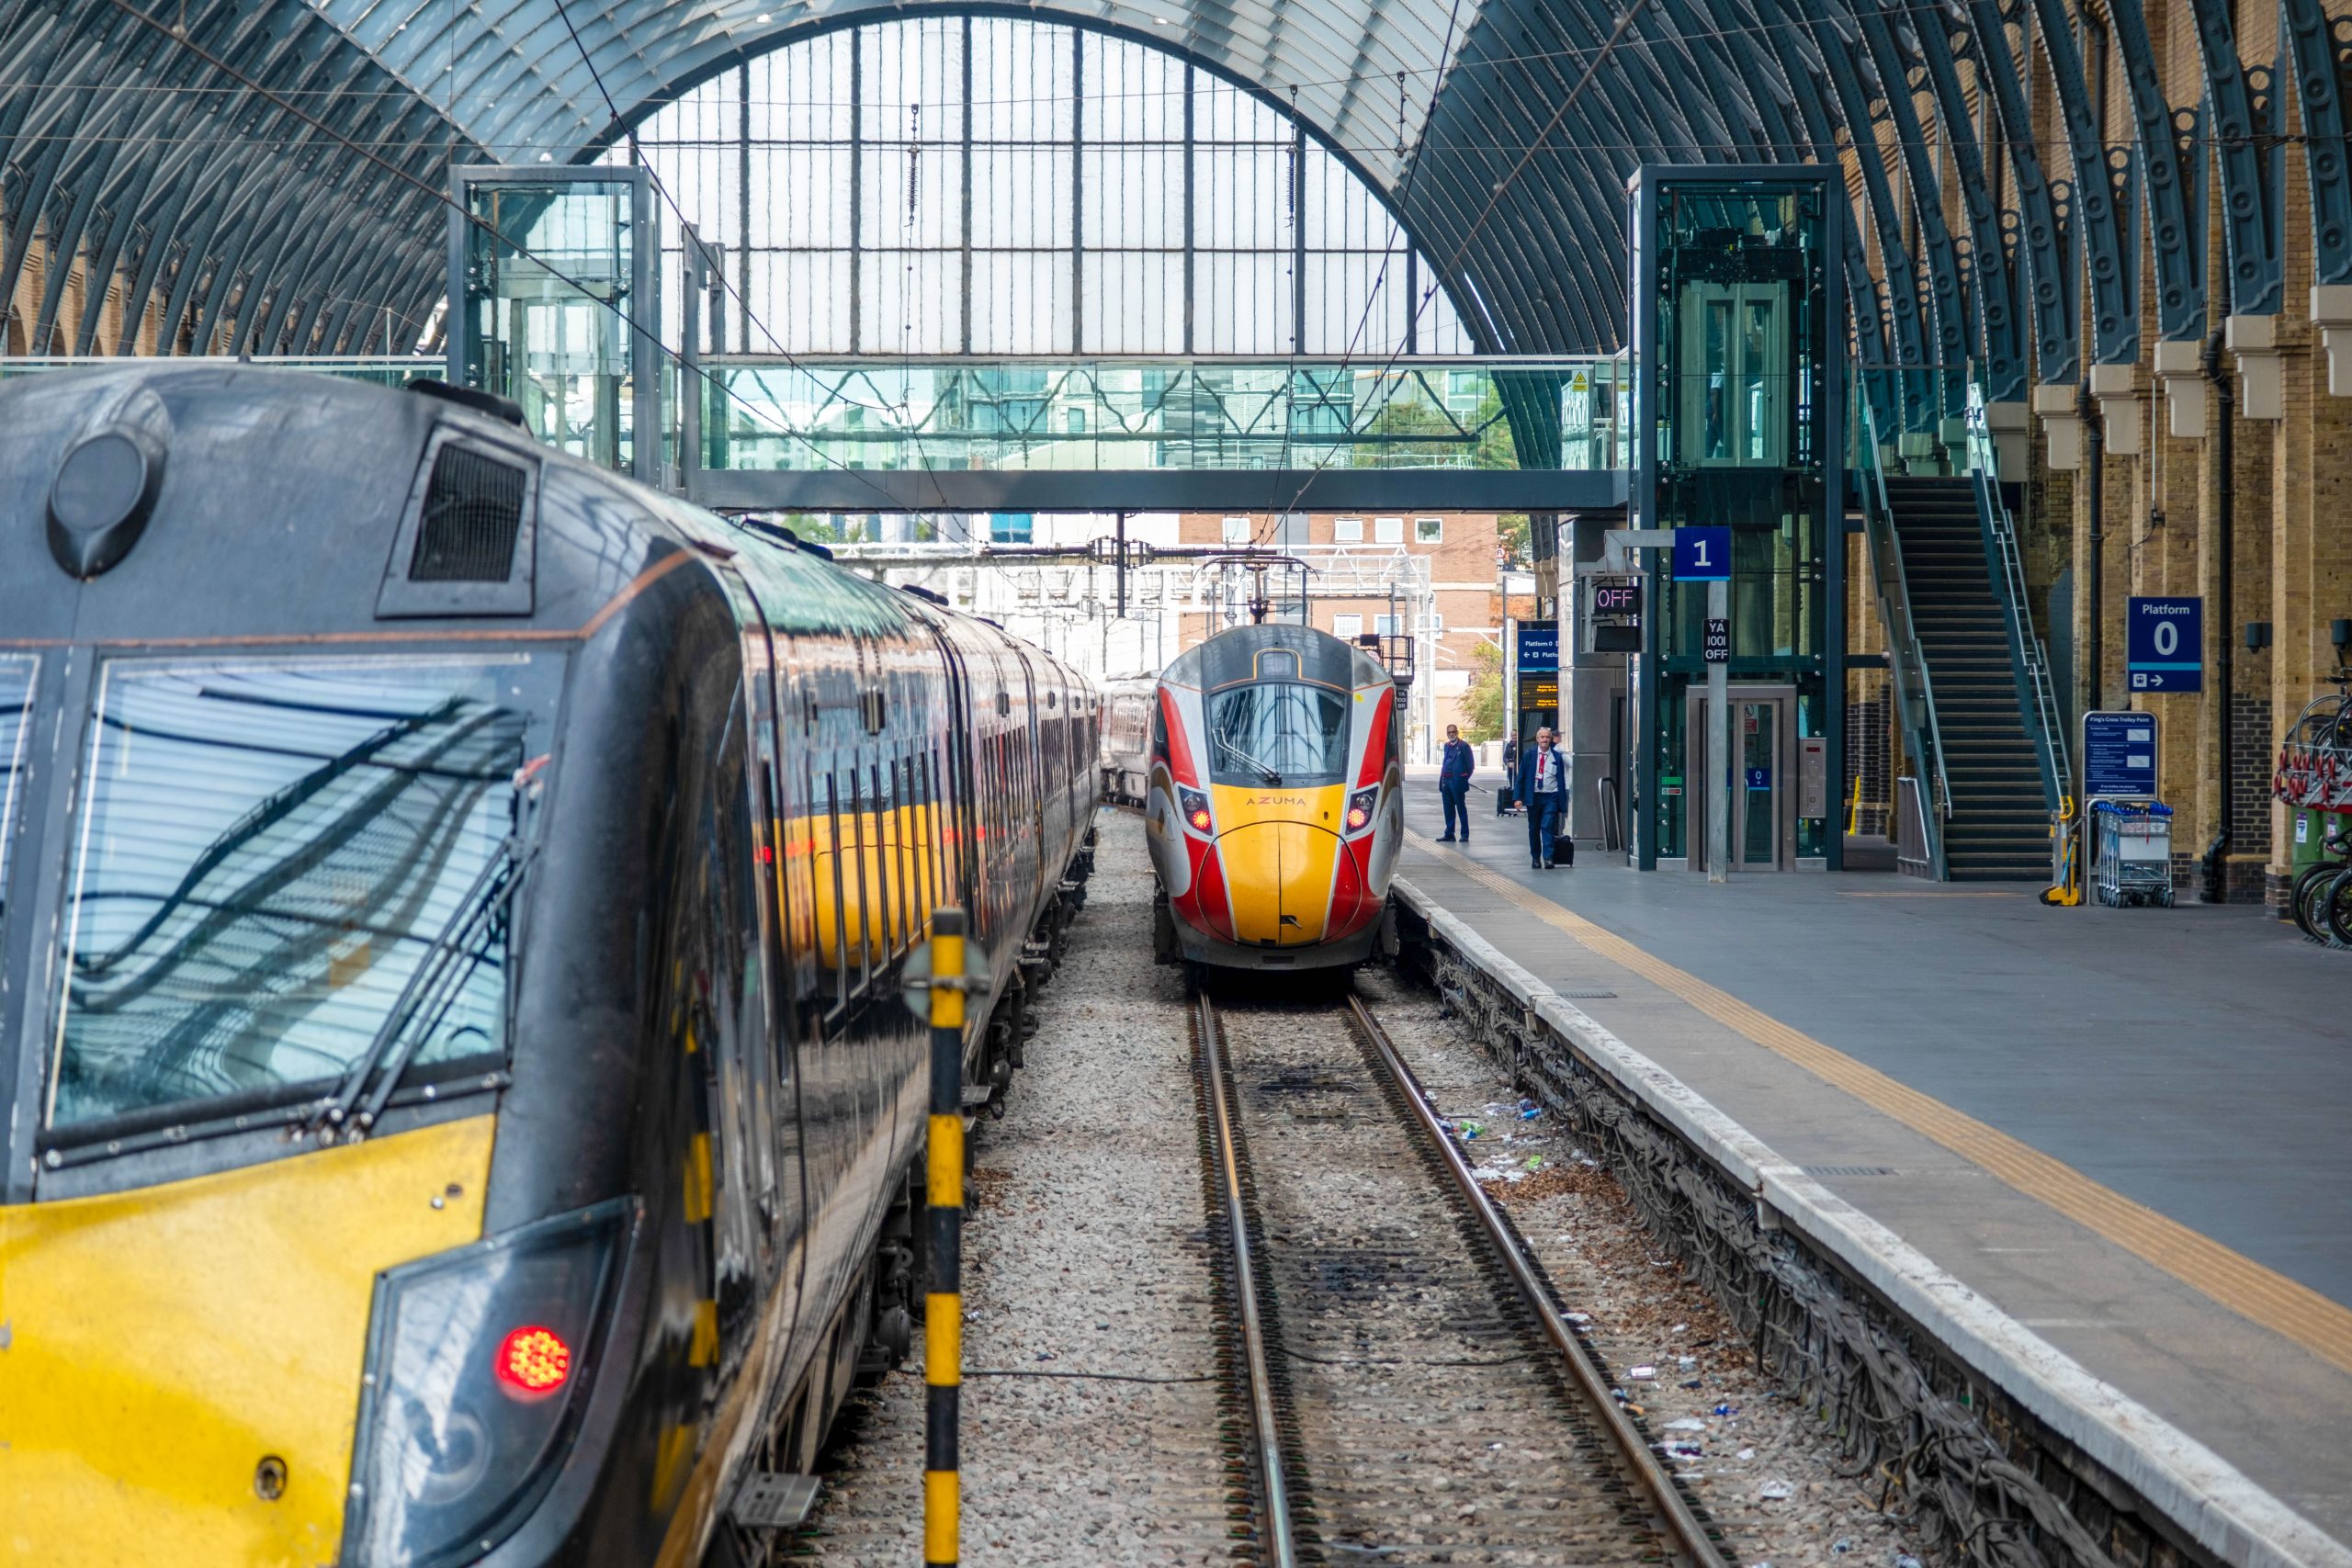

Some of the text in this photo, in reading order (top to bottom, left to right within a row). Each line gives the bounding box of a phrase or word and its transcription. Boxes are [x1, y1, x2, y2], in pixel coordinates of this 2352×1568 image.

[1693, 540, 1712, 567] 1
[1598, 590, 1634, 607] OFF
[2142, 604, 2190, 615] Platform
[1709, 623, 1724, 634] YA
[2154, 621, 2178, 656] 0
[1705, 649, 1728, 660] OFF
[1247, 796, 1306, 806] AZUMA
